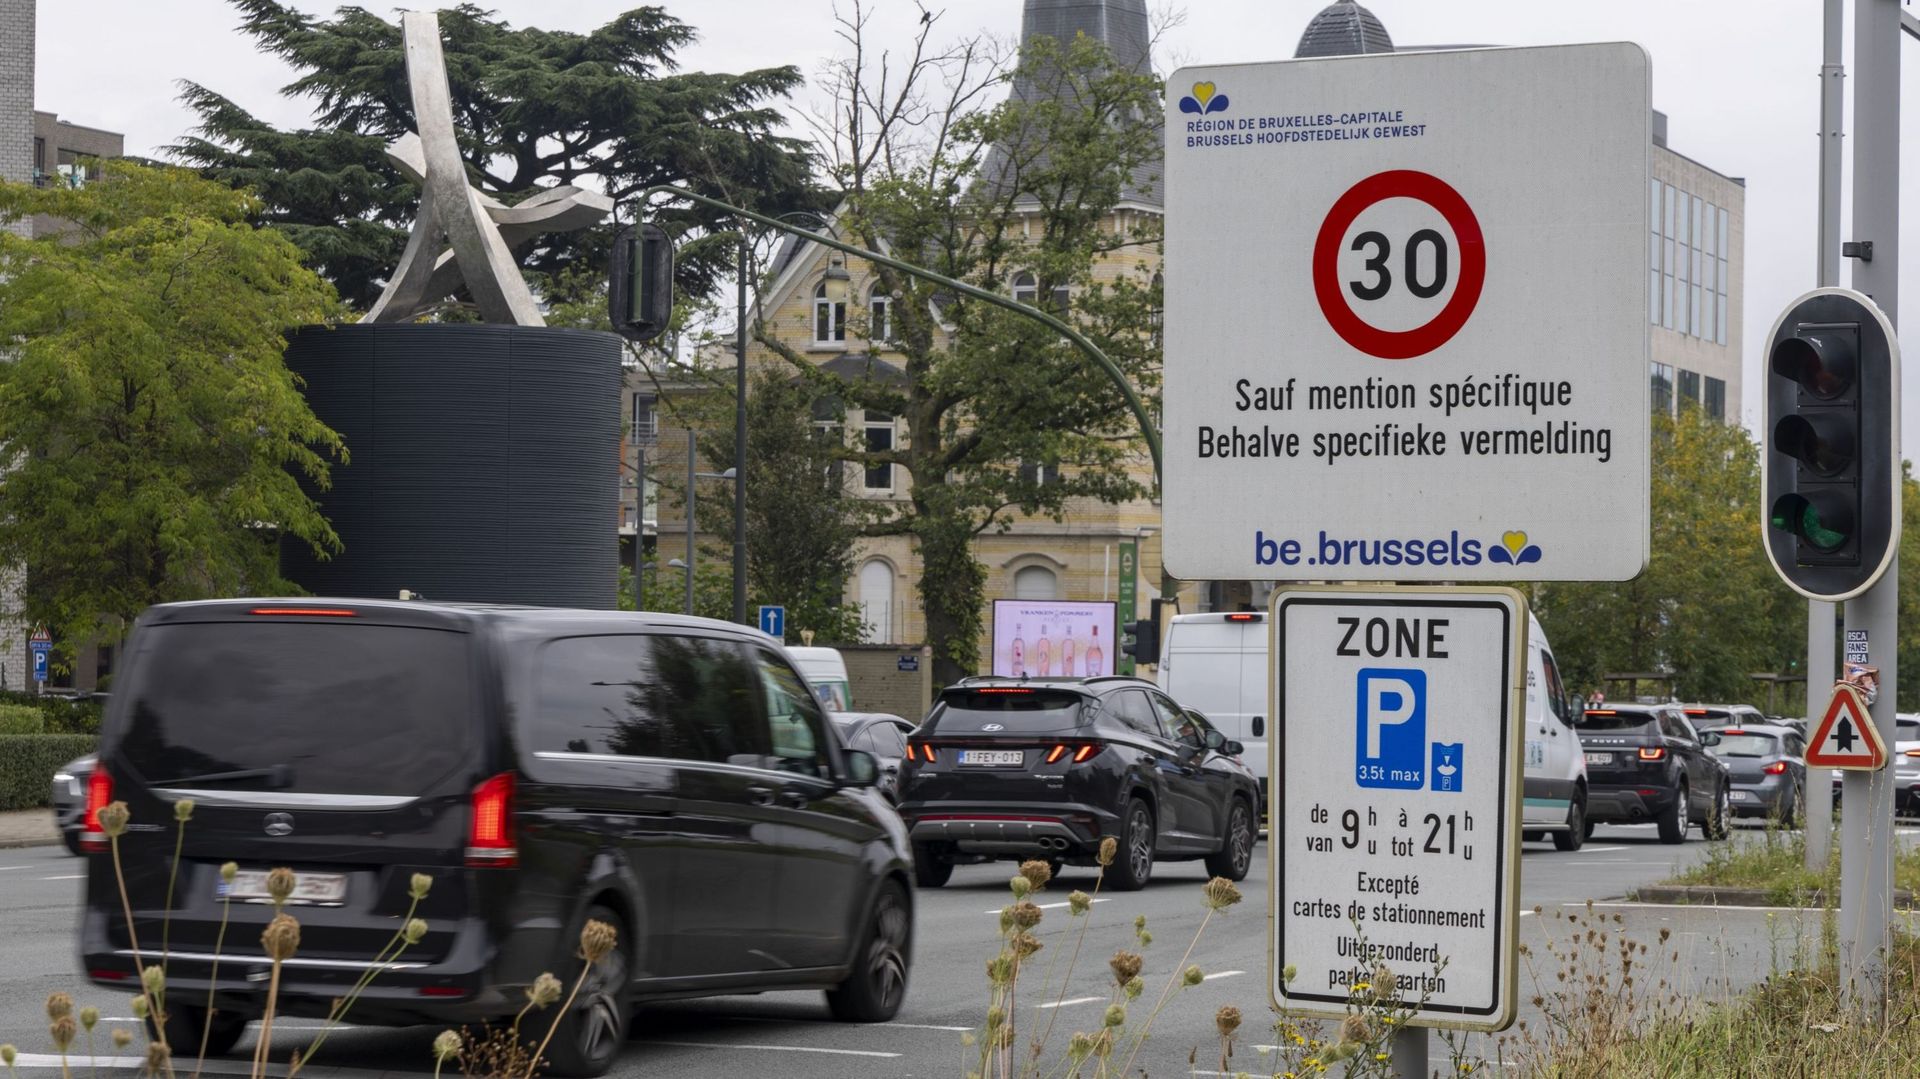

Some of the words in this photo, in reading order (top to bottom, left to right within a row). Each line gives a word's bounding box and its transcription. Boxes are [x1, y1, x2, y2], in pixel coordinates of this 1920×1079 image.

[1187, 118, 1235, 132] RÉGION
[1239, 118, 1255, 130] DE
[1259, 110, 1403, 128] BRUXELLES-CAPITALE
[1187, 133, 1253, 147] BRUSSELS
[1257, 130, 1370, 144] HOOFDSTEDELIJK
[1374, 124, 1427, 138] GEWEST
[1349, 228, 1448, 300] 30
[1235, 378, 1296, 411] Sauf
[1308, 377, 1416, 409] mention
[1429, 374, 1572, 416] spécifique
[1198, 425, 1300, 458] Behalve
[1312, 423, 1446, 465] specifieke
[1460, 421, 1612, 463] vermelding
[1336, 617, 1450, 659] ZONE
[1848, 643, 1867, 652] FANS
[36, 653, 45, 669] P
[1848, 654, 1867, 663] AREA
[1366, 677, 1416, 759] P
[1359, 766, 1385, 780] 3.5t
[1391, 768, 1420, 782] max
[1311, 804, 1328, 823] de
[1368, 806, 1377, 826] h
[1399, 808, 1407, 827] à
[1464, 810, 1473, 831] h
[1341, 809, 1360, 849] 9
[1423, 813, 1456, 854] 21
[1306, 836, 1333, 853] van
[1368, 839, 1376, 855] u
[1392, 837, 1414, 857] tot
[1464, 844, 1472, 860] u
[1358, 872, 1419, 899] Excepté
[1293, 898, 1341, 918] cartes
[1348, 900, 1366, 920] de
[1372, 903, 1485, 928] stationnement
[1337, 936, 1439, 963] Uitgezonderd
